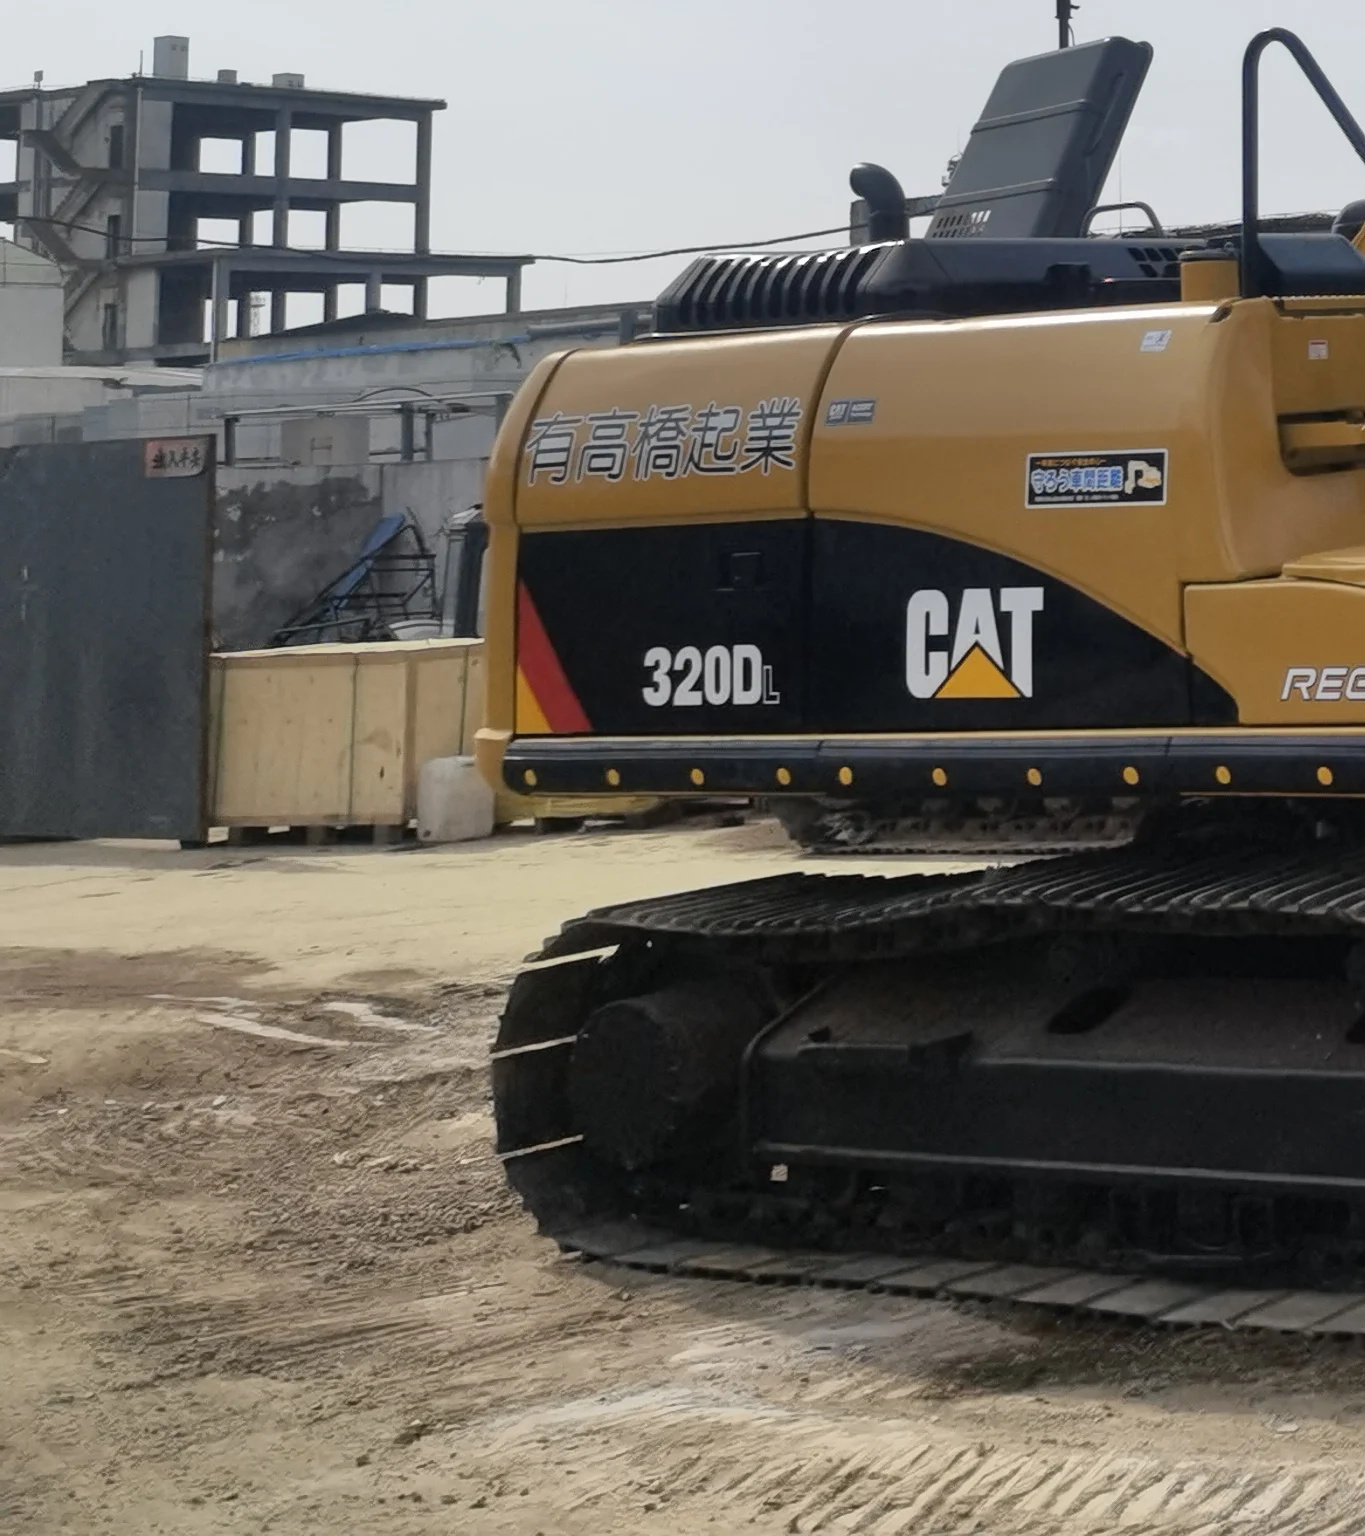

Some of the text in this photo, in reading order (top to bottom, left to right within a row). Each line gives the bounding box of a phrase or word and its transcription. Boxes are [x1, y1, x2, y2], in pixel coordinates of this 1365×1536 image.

[525, 396, 802, 486] 有高橋起業
[906, 586, 1044, 699] CAT
